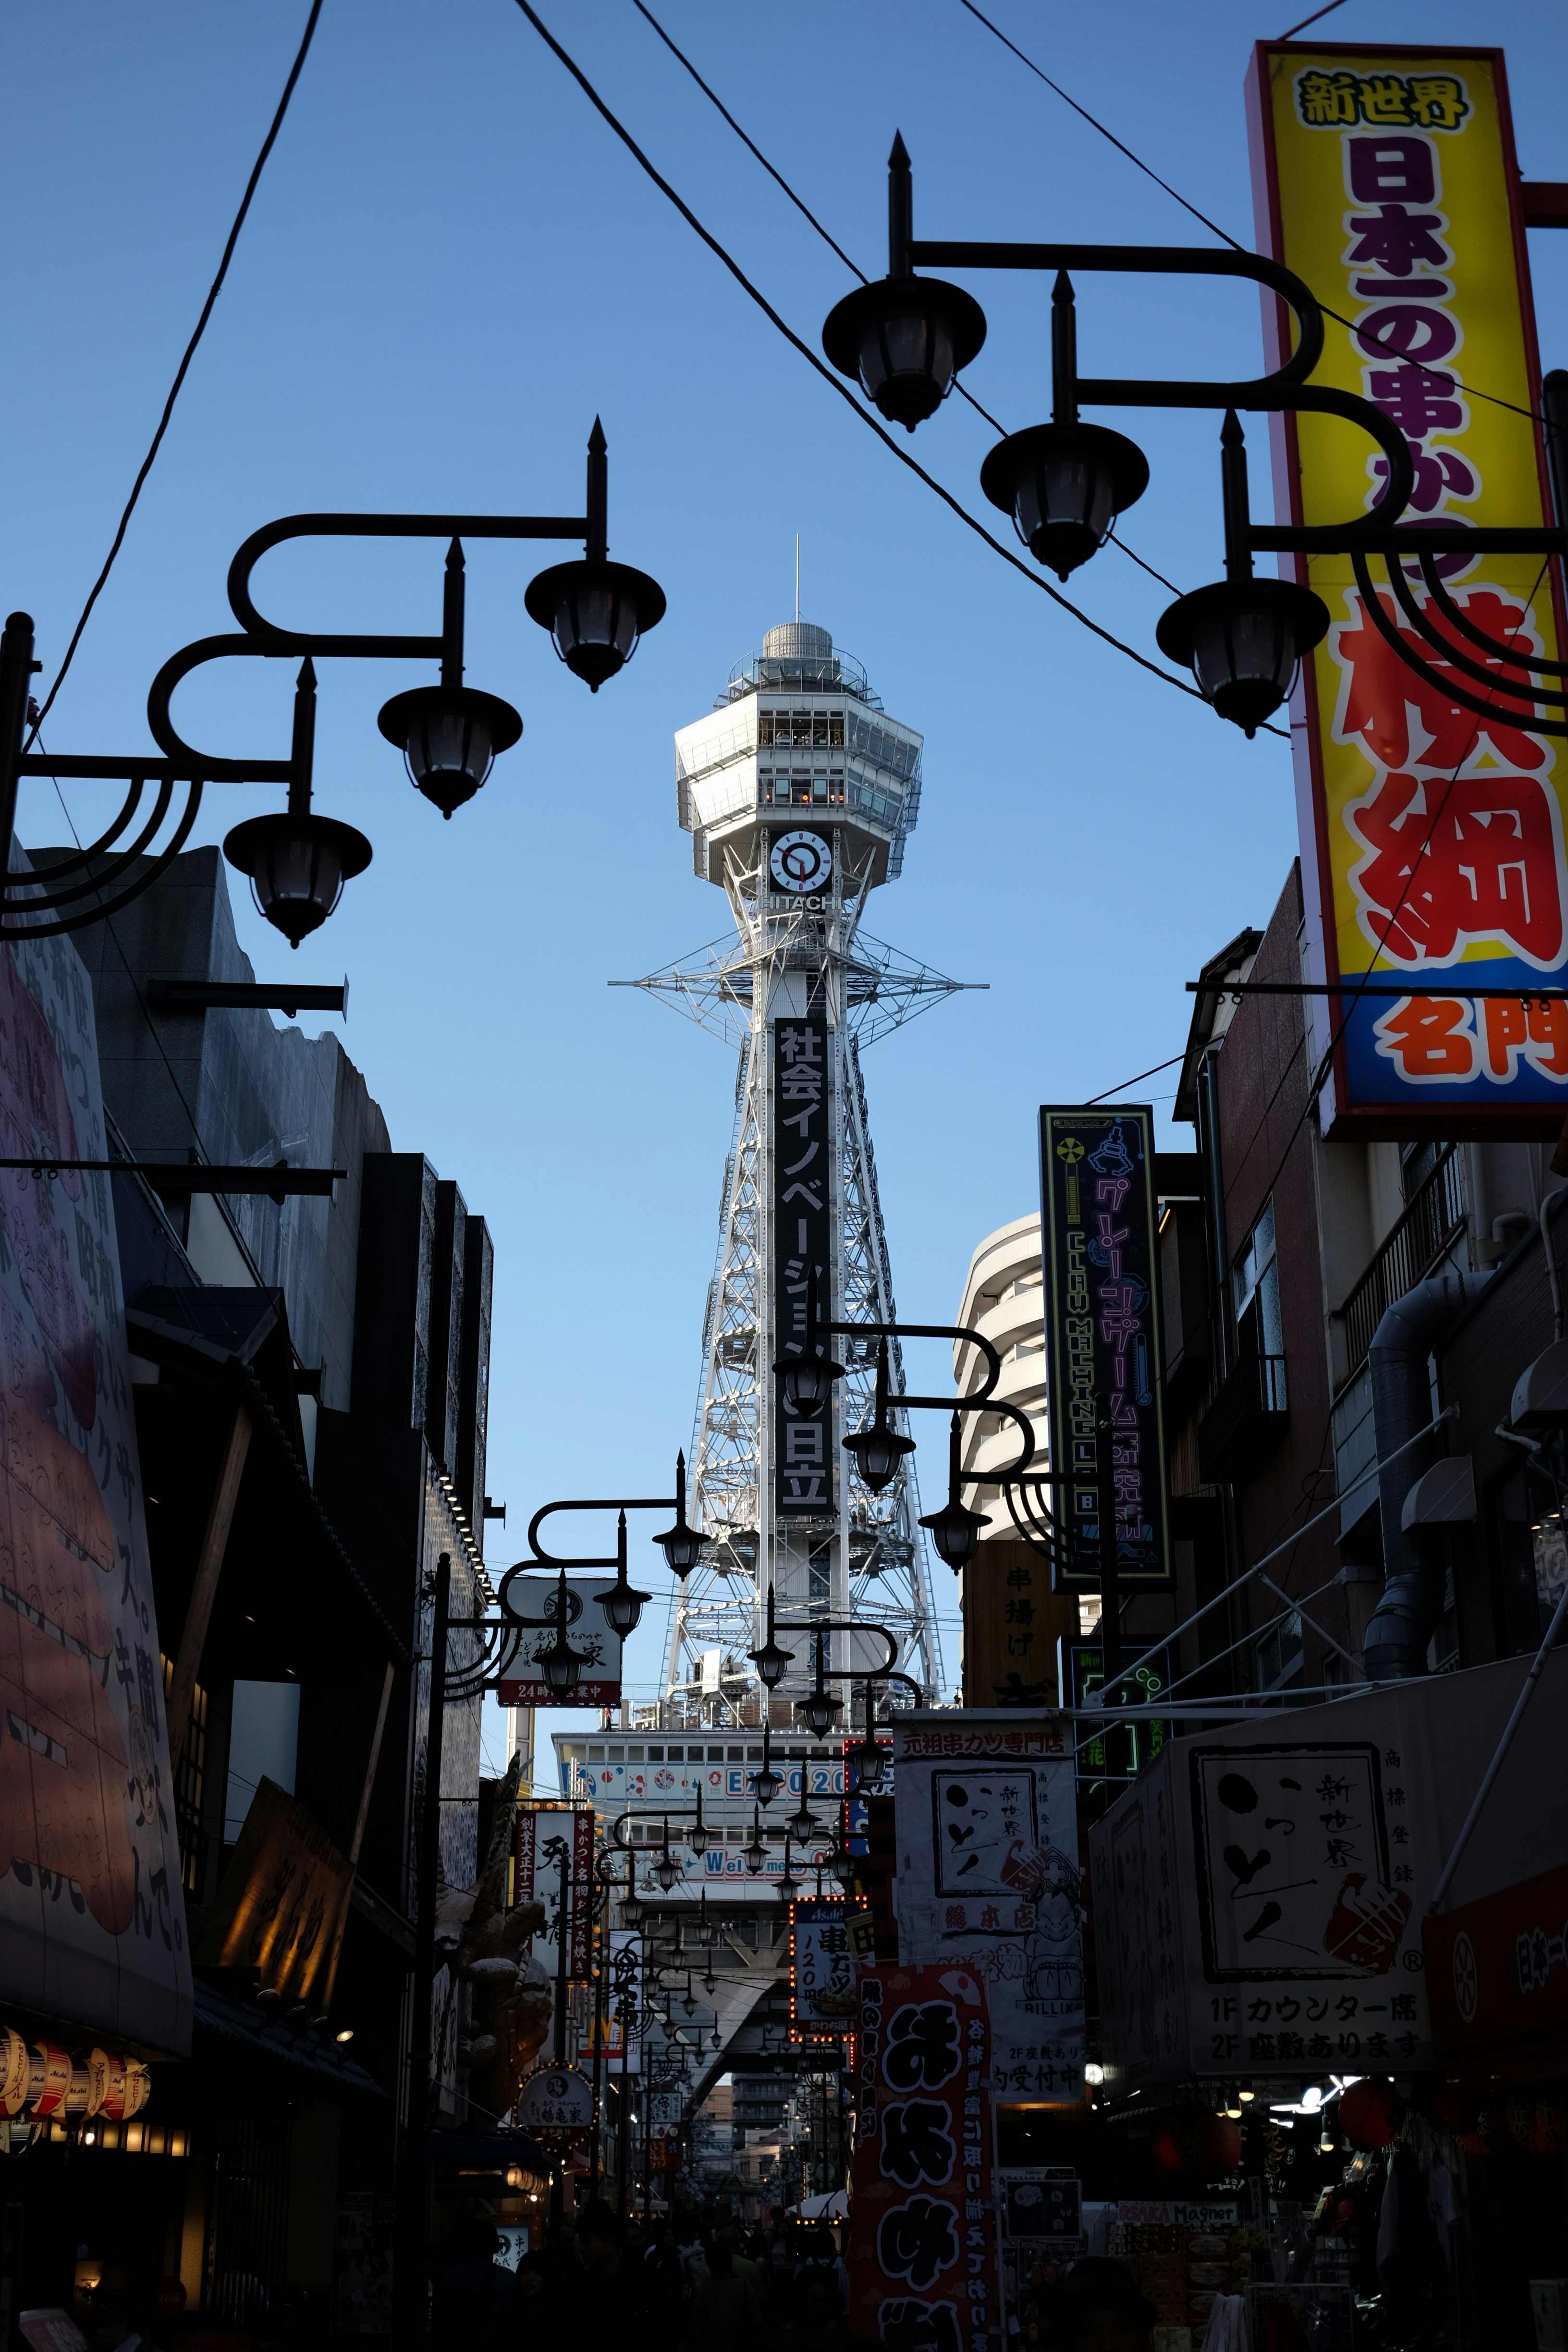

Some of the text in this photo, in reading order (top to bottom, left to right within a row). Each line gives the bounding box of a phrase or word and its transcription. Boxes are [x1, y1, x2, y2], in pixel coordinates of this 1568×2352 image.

[1298, 71, 1469, 130] 新世界
[1336, 589, 1566, 967] 横綱
[760, 896, 842, 910] HITACHI
[1067, 1231, 1089, 1314] CLAW
[1066, 1318, 1096, 1435] MACHINE
[1005, 1567, 1035, 1656] 串揚げ
[903, 1732, 1065, 1755] 元祖串カツ専門店
[1000, 1784, 1025, 1837] 新世界
[1038, 1771, 1051, 1846] 商標登録
[1316, 1775, 1362, 1868] 新世界
[1384, 1749, 1415, 1884] 商標登録
[945, 1903, 1038, 1930] 総本店
[818, 1925, 851, 1995] 串カツ
[809, 2021, 848, 2031] かわち屋
[50, 2070, 67, 2079] Asahi
[89, 2071, 101, 2111] アサヒビール
[542, 2107, 583, 2124] 鶴亀家
[1119, 2205, 1234, 2227] OSAKA Magnet
